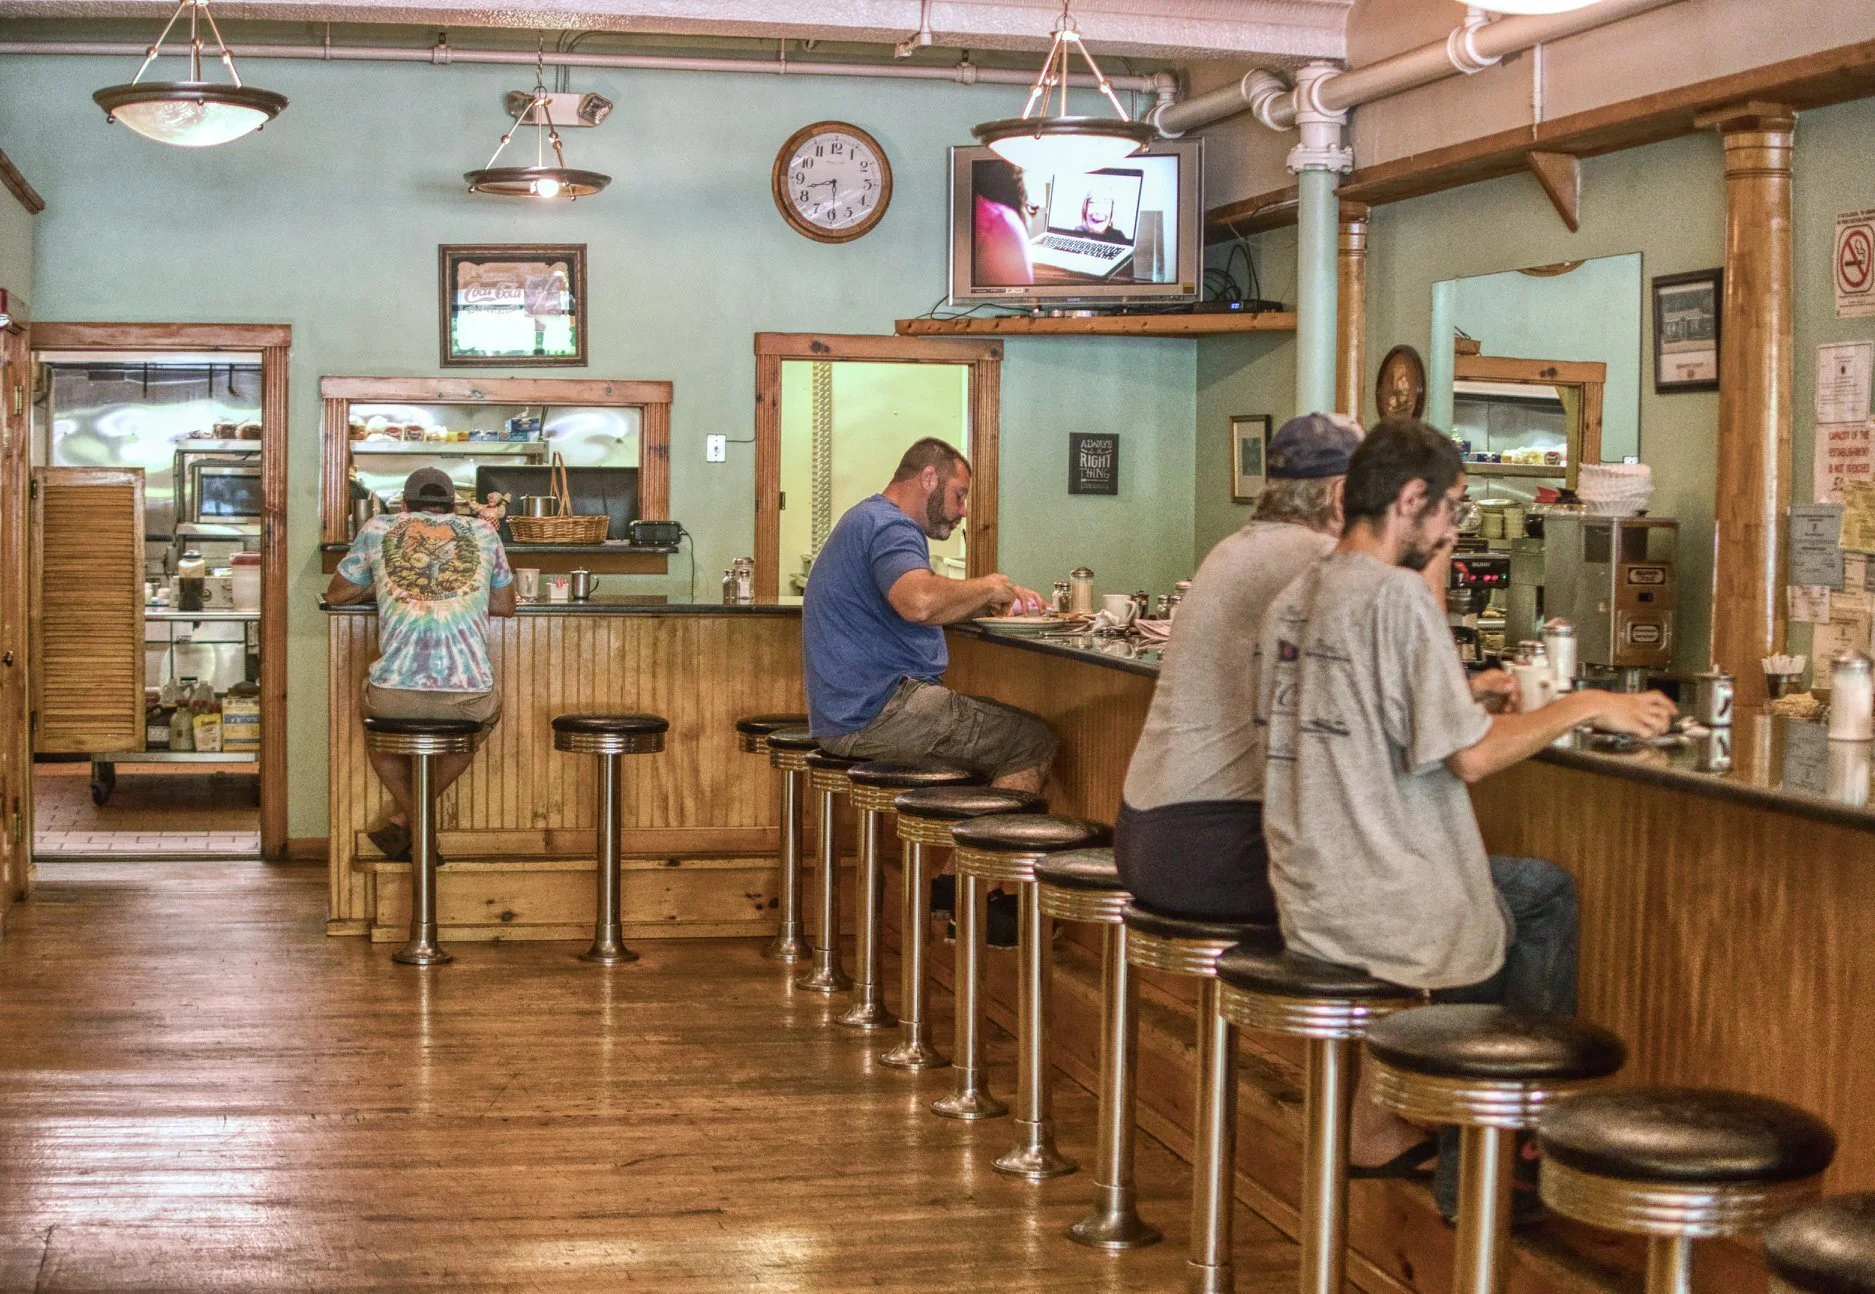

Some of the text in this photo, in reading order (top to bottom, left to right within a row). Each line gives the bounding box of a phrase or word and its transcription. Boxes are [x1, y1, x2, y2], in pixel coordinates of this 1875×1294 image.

[815, 145, 824, 157] 11
[831, 142, 843, 155] 12
[849, 149, 854, 160] 1
[802, 158, 814, 169] 10
[860, 160, 868, 172] 2
[796, 172, 805, 185] 9
[799, 190, 809, 202] 8
[858, 194, 865, 206] 4
[813, 203, 821, 214] 7
[844, 207, 853, 218] 5
[827, 209, 836, 221] 6
[1080, 440, 1112, 448] ALWAYS
[1080, 453, 1112, 468] RIGHT
[1079, 468, 1110, 478] THING
